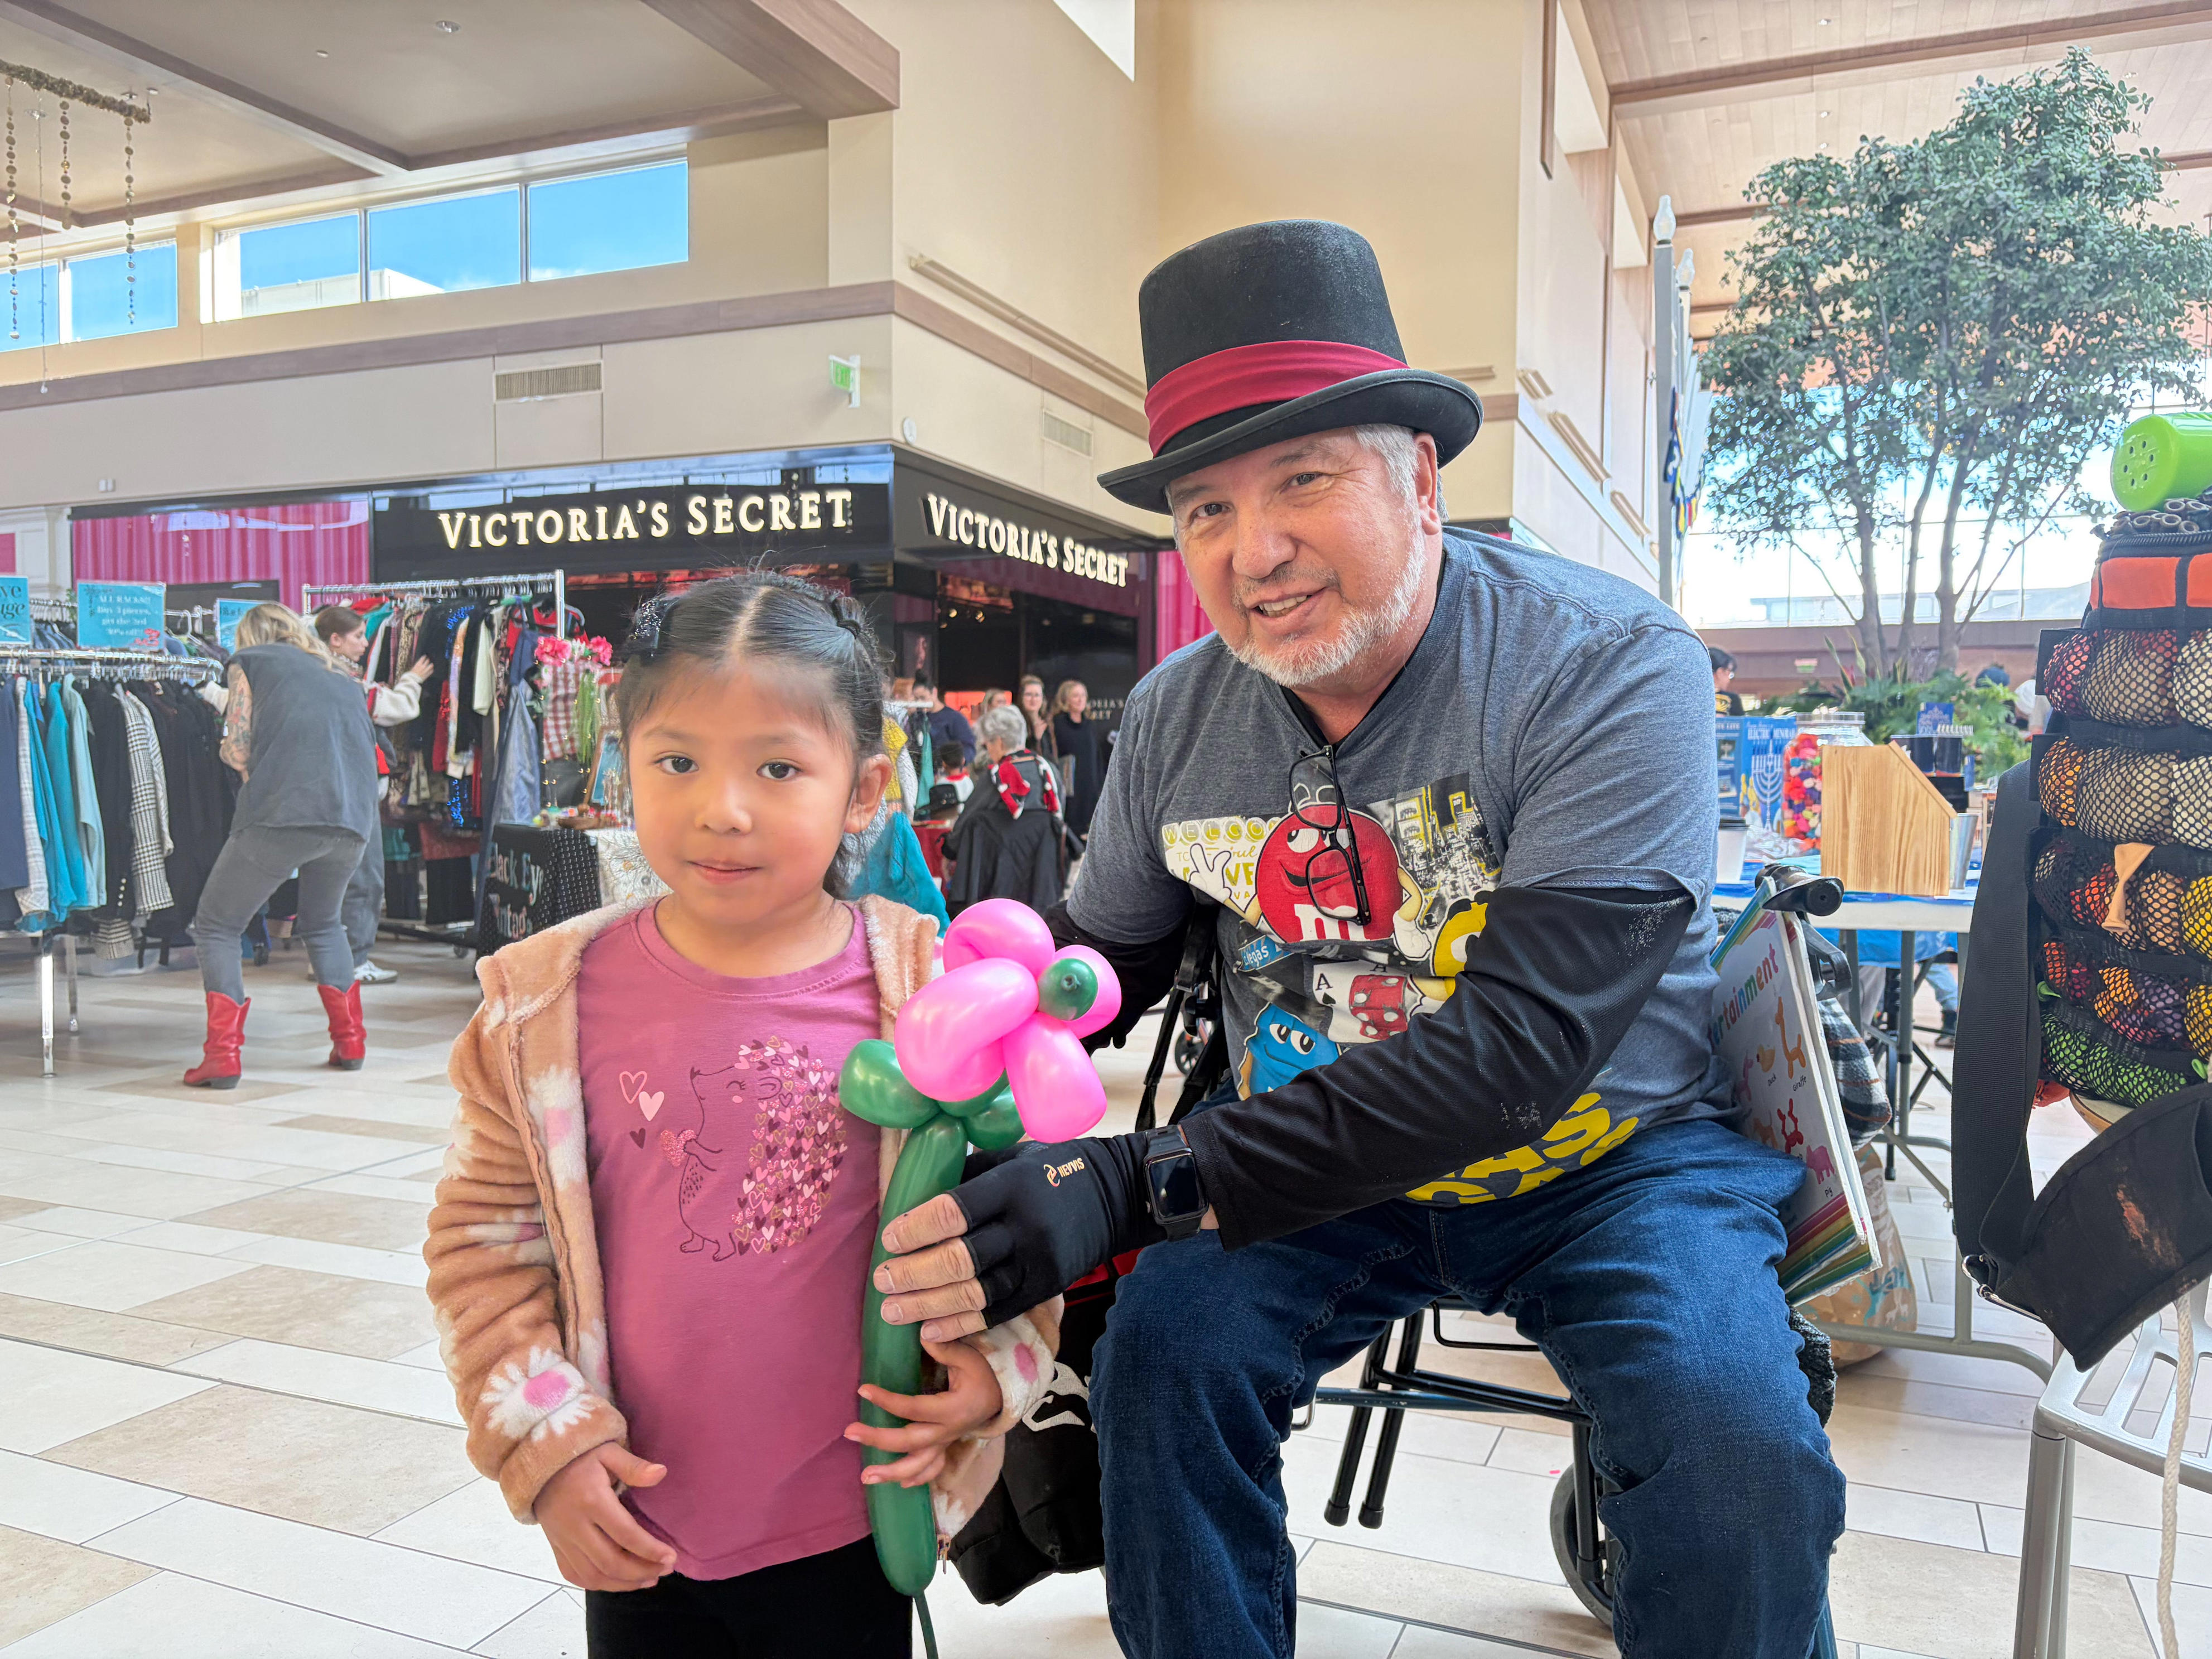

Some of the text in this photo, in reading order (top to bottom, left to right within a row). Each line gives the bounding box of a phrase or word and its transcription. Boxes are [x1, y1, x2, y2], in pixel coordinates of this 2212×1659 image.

[438, 490, 852, 549] VICTORIA'S SECRET
[927, 494, 1128, 587] VICTORIA'S SECRET
[1707, 942, 1779, 1052] tertainment
